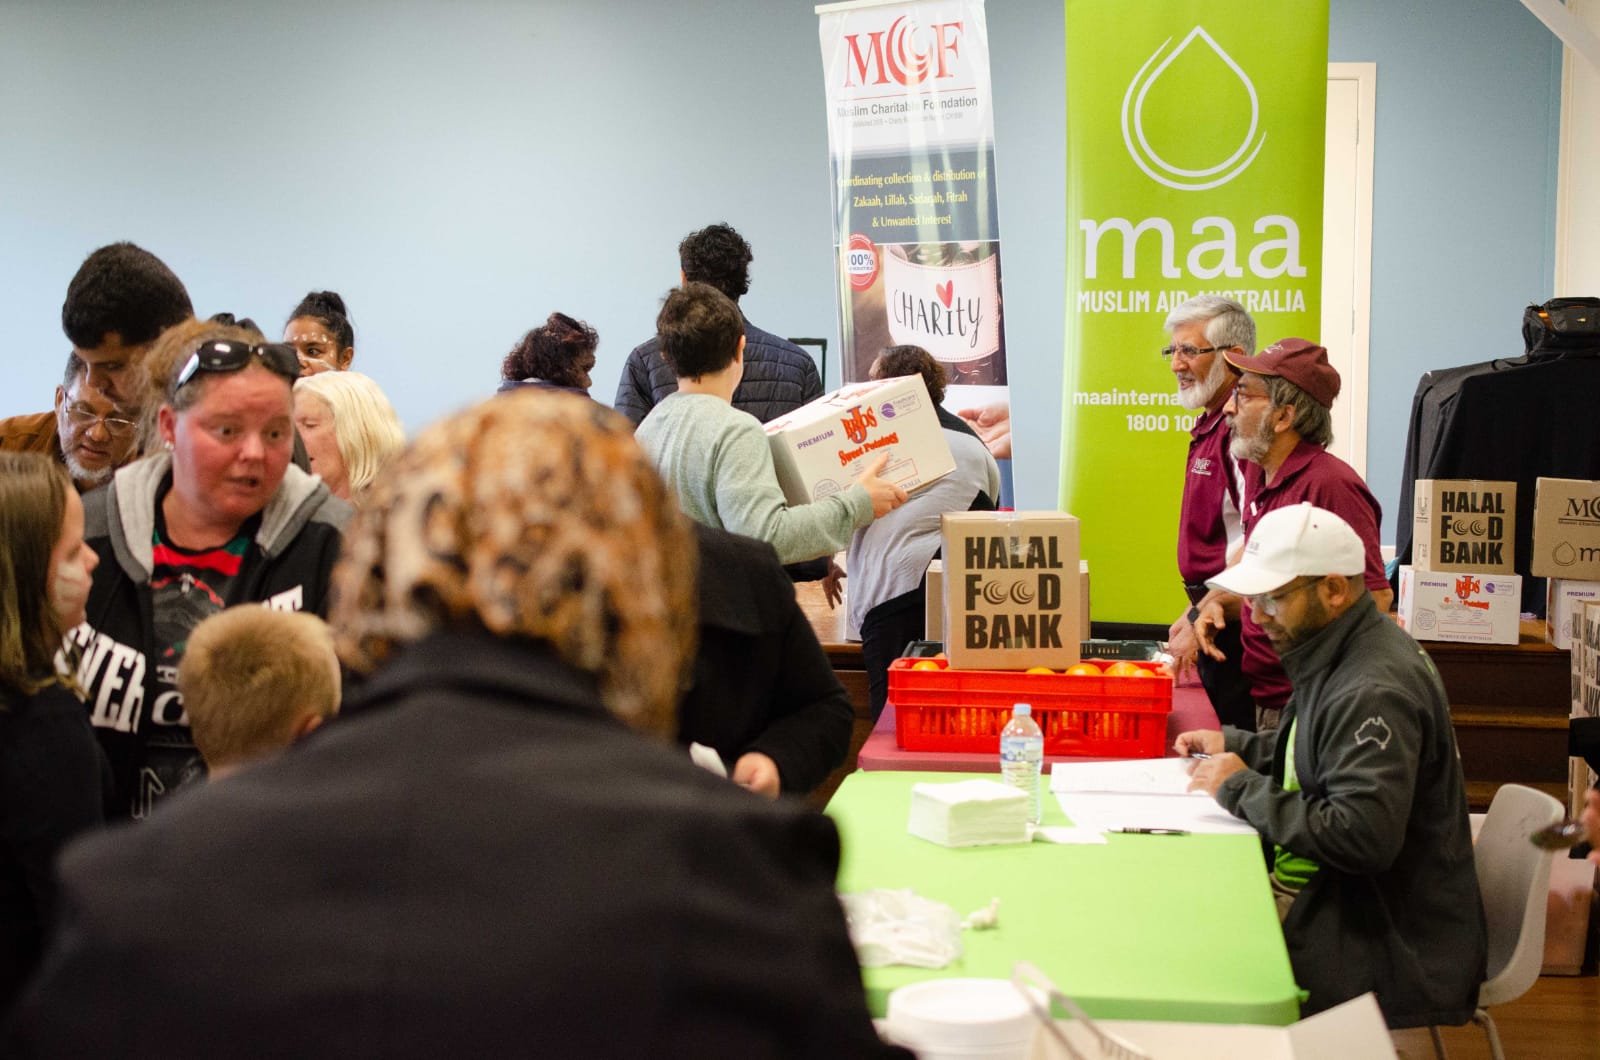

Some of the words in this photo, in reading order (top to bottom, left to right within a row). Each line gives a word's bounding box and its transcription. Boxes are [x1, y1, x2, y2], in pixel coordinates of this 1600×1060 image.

[924, 96, 977, 110] Fondation
[880, 216, 920, 227] Unwanted
[1080, 215, 1307, 279] maa
[1077, 290, 1150, 313] MUSLIM
[1126, 414, 1169, 432] 1800
[797, 430, 834, 450] PREMIUM
[1441, 491, 1505, 514] HALAL
[965, 536, 1063, 569] HALAL
[1440, 541, 1504, 565] BANK
[965, 614, 1063, 649] BANK
